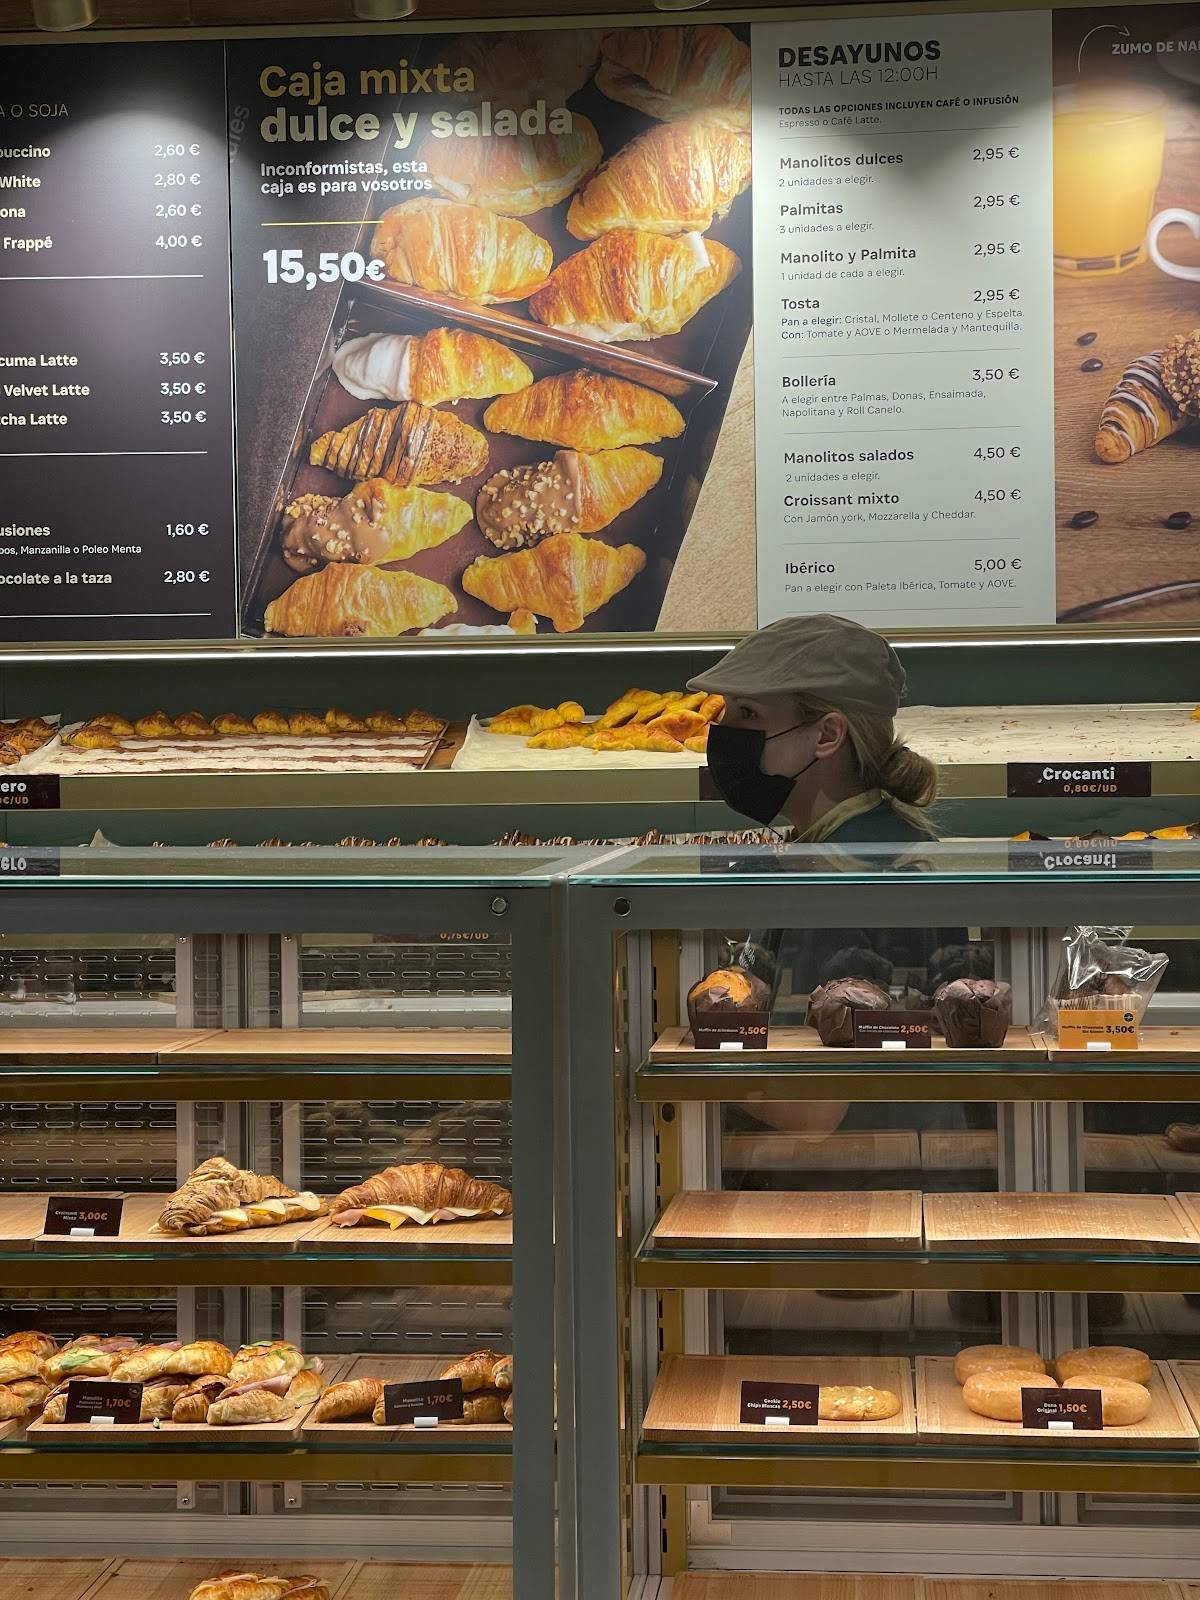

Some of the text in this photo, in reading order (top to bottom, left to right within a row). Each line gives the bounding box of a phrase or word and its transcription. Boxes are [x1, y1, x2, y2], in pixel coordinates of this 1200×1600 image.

[778, 40, 941, 67] DESAYUNOS
[1112, 41, 1200, 55] ZUMO DE NA
[259, 59, 475, 106] Caja mixta
[779, 66, 938, 88] HASTA LAS 12:00H
[11, 103, 69, 117] O SOJA
[779, 94, 1019, 114] TODAS LAS OPCIONES INCLUYEN CAFÉ INFUSIÓN
[260, 106, 380, 143] dulce
[393, 111, 418, 149] y
[431, 99, 573, 138] salada
[779, 116, 853, 128] Espresso Café
[154, 144, 200, 158] 2,60 €
[973, 147, 1020, 161] 2,95 €
[780, 152, 903, 169] Manolitos dulces
[260, 159, 427, 177] Inconformistas, esta
[0, 175, 41, 188] White
[154, 173, 201, 187] 2,80 €
[261, 177, 432, 196] caja es para vosotros
[787, 176, 832, 187] unidades
[973, 194, 1020, 209] 2,95 €
[156, 204, 201, 218] 2,60 €
[781, 203, 843, 217] Palmitas
[788, 222, 874, 234] unidades elegir.
[4, 237, 52, 251] Frappé
[156, 235, 202, 249] 4,00 €
[781, 247, 916, 264] Manolito Palmita
[974, 242, 1021, 257] 2,95 €
[262, 248, 385, 291] 15,50€
[788, 267, 904, 280] unidad cada elegir.
[973, 288, 1020, 303] 2,95 €
[781, 298, 820, 310] Tosta
[781, 309, 1024, 326] Pan elegir: Cristal, Mollete Centeno Espelta.
[781, 323, 1022, 340] Con: Tomate AOVE Mermelada Mantequilla.
[40, 354, 78, 367] Latte
[160, 352, 205, 365] 3,50 €
[782, 374, 836, 388] Bollería
[972, 368, 1019, 382] 3,50 €
[3, 384, 90, 396] Velvet Latte
[161, 382, 206, 396] 3,50 €
[791, 389, 986, 405] elegir entre Palmas, Donas, Ensaimada,
[161, 411, 207, 424] 3,50 €
[782, 405, 904, 418] Napolitana Roll Canelo.
[0, 413, 68, 425] cha Latte
[784, 448, 914, 464] Manolitos salados
[973, 446, 1021, 461] 4,50 €
[794, 472, 839, 482] unidades
[784, 492, 899, 507] Croissant mixto
[974, 489, 1021, 503] 4,50 €
[784, 509, 975, 523] Con Jamón york, Mozzarella Cheddar.
[166, 524, 209, 537] 1,60 €
[20, 544, 141, 555] Manzanilla Poleo Menta
[785, 561, 835, 574] Ibérico
[974, 558, 1022, 572] 5,00 €
[66, 572, 78, 584] la
[81, 573, 112, 584] taza
[164, 571, 210, 584] 2,80 €
[785, 584, 803, 593] Pan
[814, 583, 842, 593] elegir
[866, 581, 896, 592] Paleta
[899, 581, 936, 591] Ibérica,
[939, 580, 975, 590] Tomate
[987, 579, 1016, 588] AOVE.
[1042, 766, 1115, 780] Crocanti
[0, 782, 27, 793] ero
[1063, 784, 1117, 794] 0,80€/UD
[0, 796, 29, 805] €/UD
[740, 1026, 766, 1035] 2,50€
[901, 1025, 928, 1034] 2,50€
[1106, 1026, 1134, 1034] 3,50€
[78, 1212, 108, 1221] 3,00€
[106, 1398, 132, 1408] 1,70€
[427, 1394, 453, 1405] 1,70€
[782, 1400, 812, 1410] 2,50€
[1059, 1403, 1088, 1413] 1,50€
